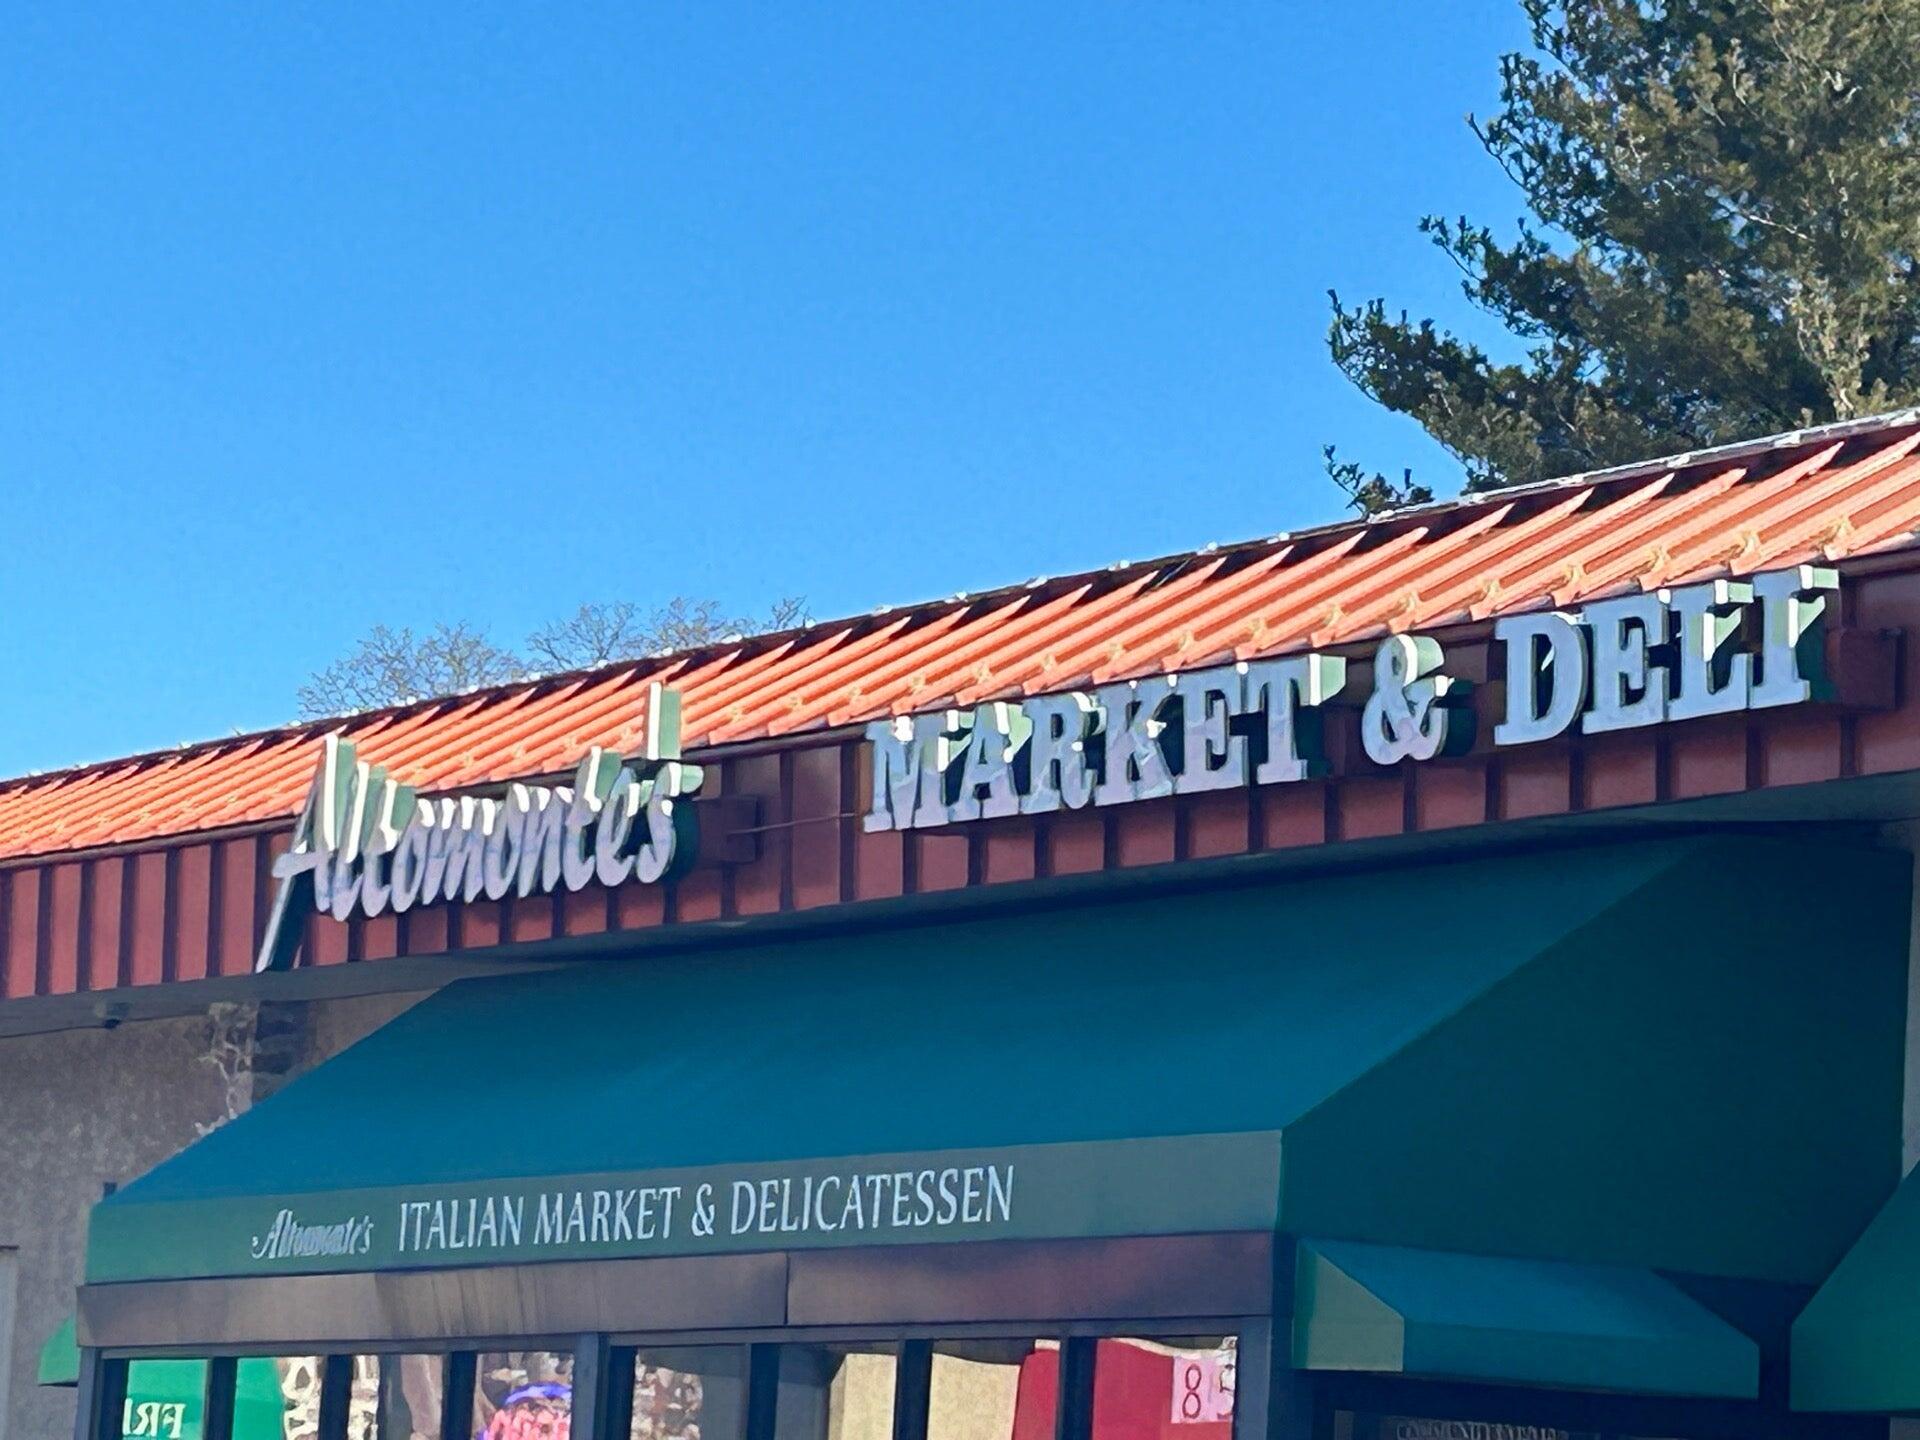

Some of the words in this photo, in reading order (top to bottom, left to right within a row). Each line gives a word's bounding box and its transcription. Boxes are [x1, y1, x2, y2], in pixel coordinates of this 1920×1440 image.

[256, 682, 704, 973] Altomonte's
[864, 653, 1345, 832] MARKET
[1362, 634, 1456, 765] &
[1494, 566, 1839, 745] DELI
[399, 1197, 524, 1252] ITALIAN
[534, 1190, 682, 1243] MARKET
[691, 1184, 716, 1237] &
[731, 1165, 1014, 1235] DELICATESSEN
